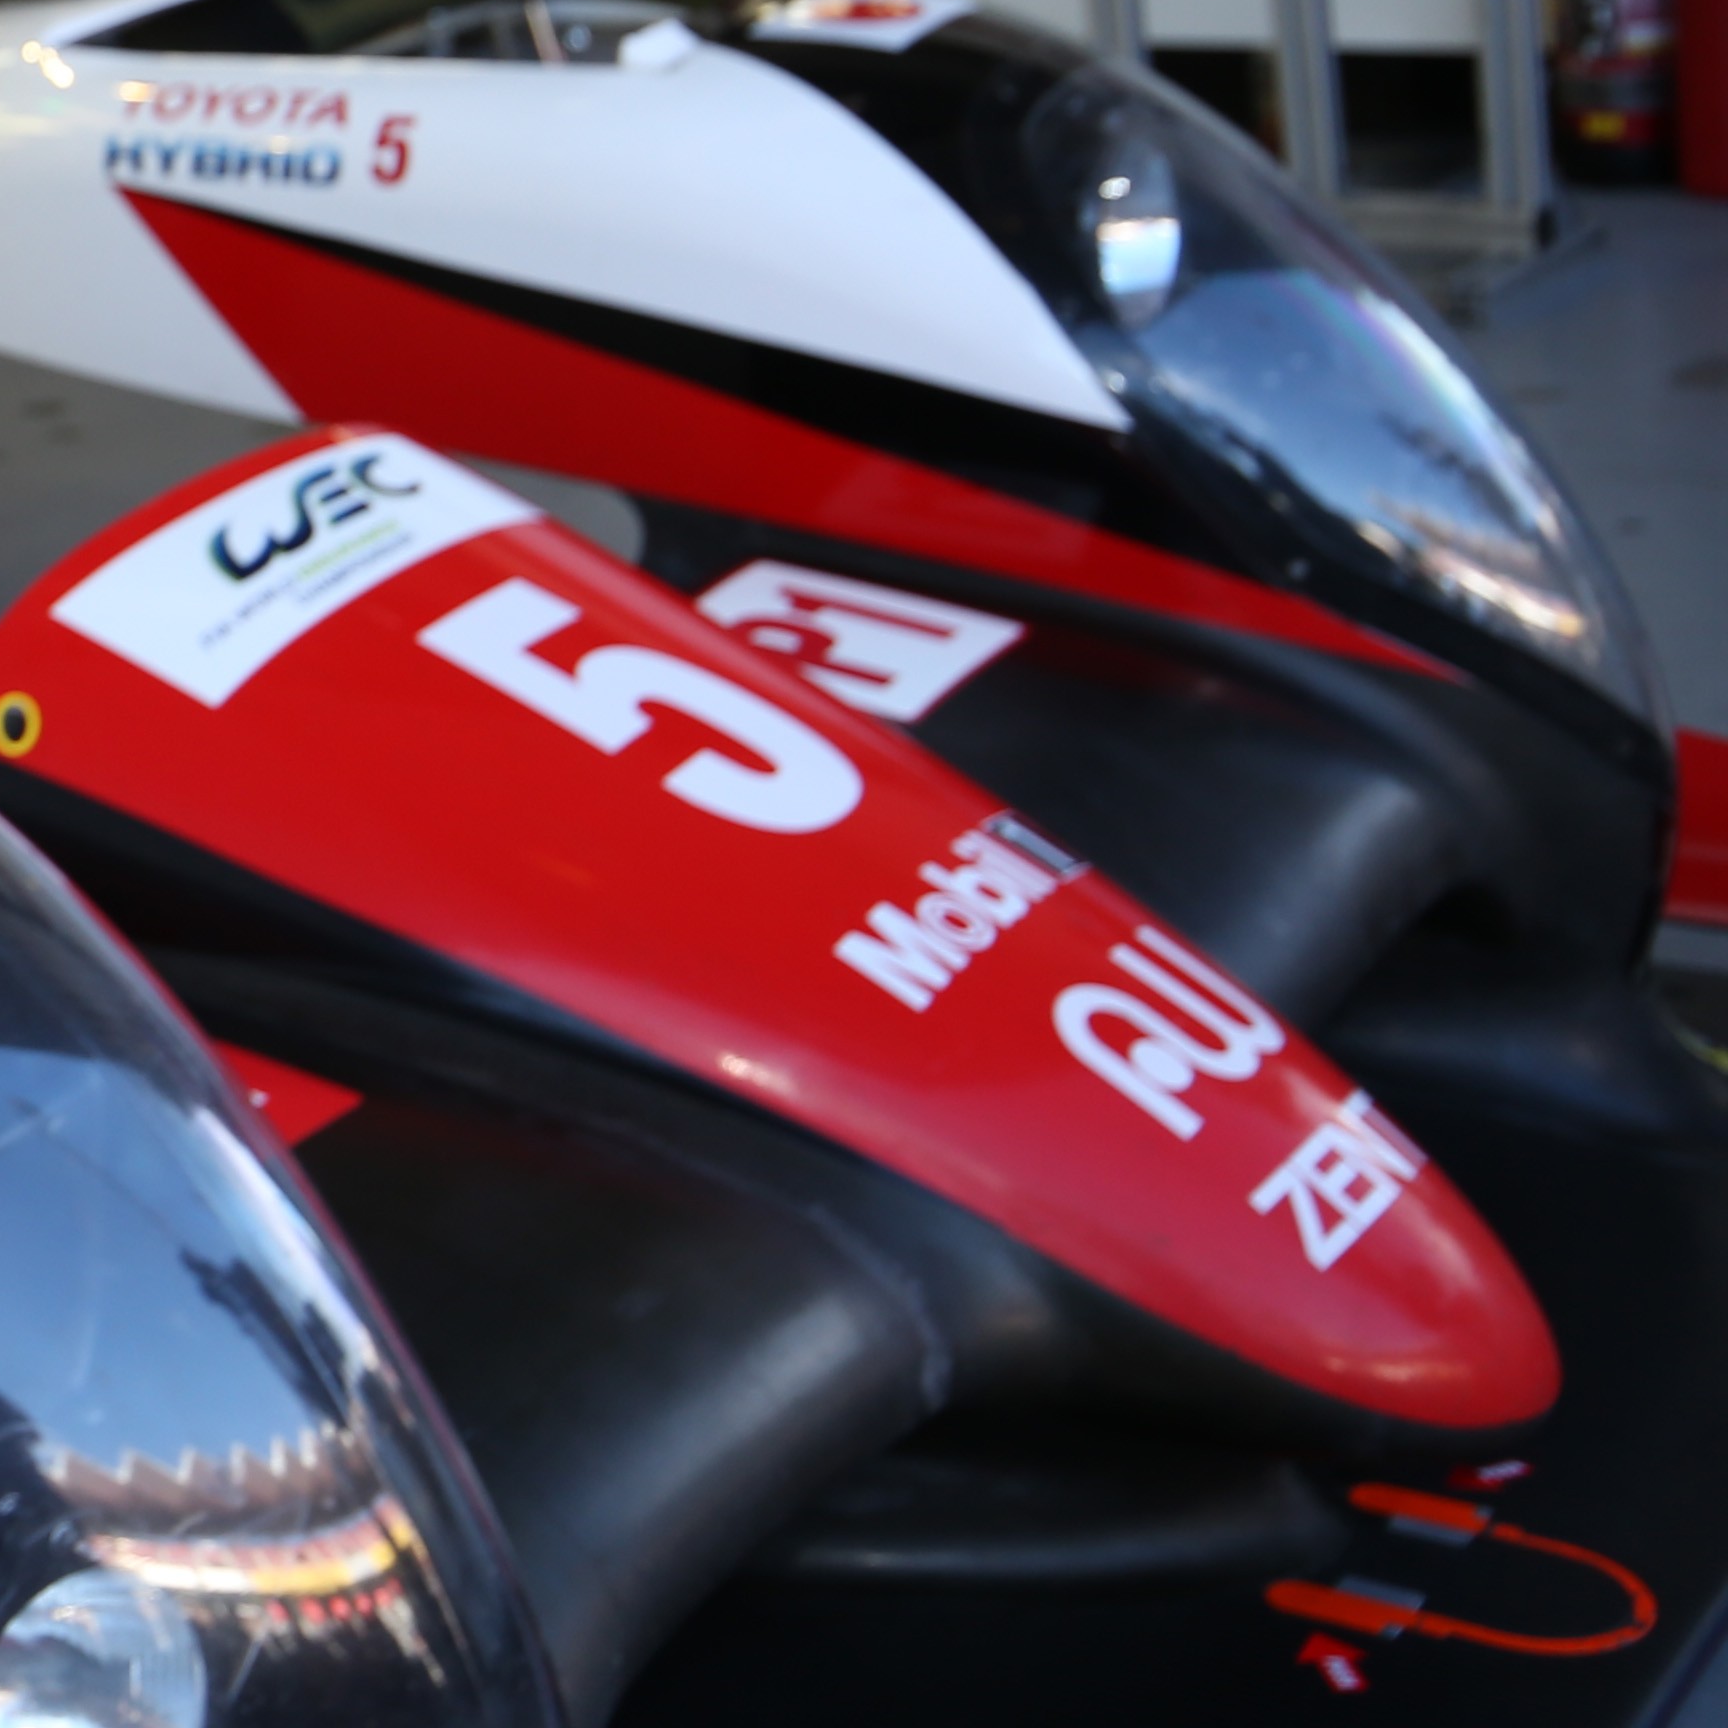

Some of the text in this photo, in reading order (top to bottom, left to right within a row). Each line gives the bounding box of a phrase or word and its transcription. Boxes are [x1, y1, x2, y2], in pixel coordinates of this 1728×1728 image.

[370, 112, 417, 184] 5
[209, 452, 420, 583] WEC
[417, 577, 864, 833] 5
[833, 828, 1058, 1014] Mobil
